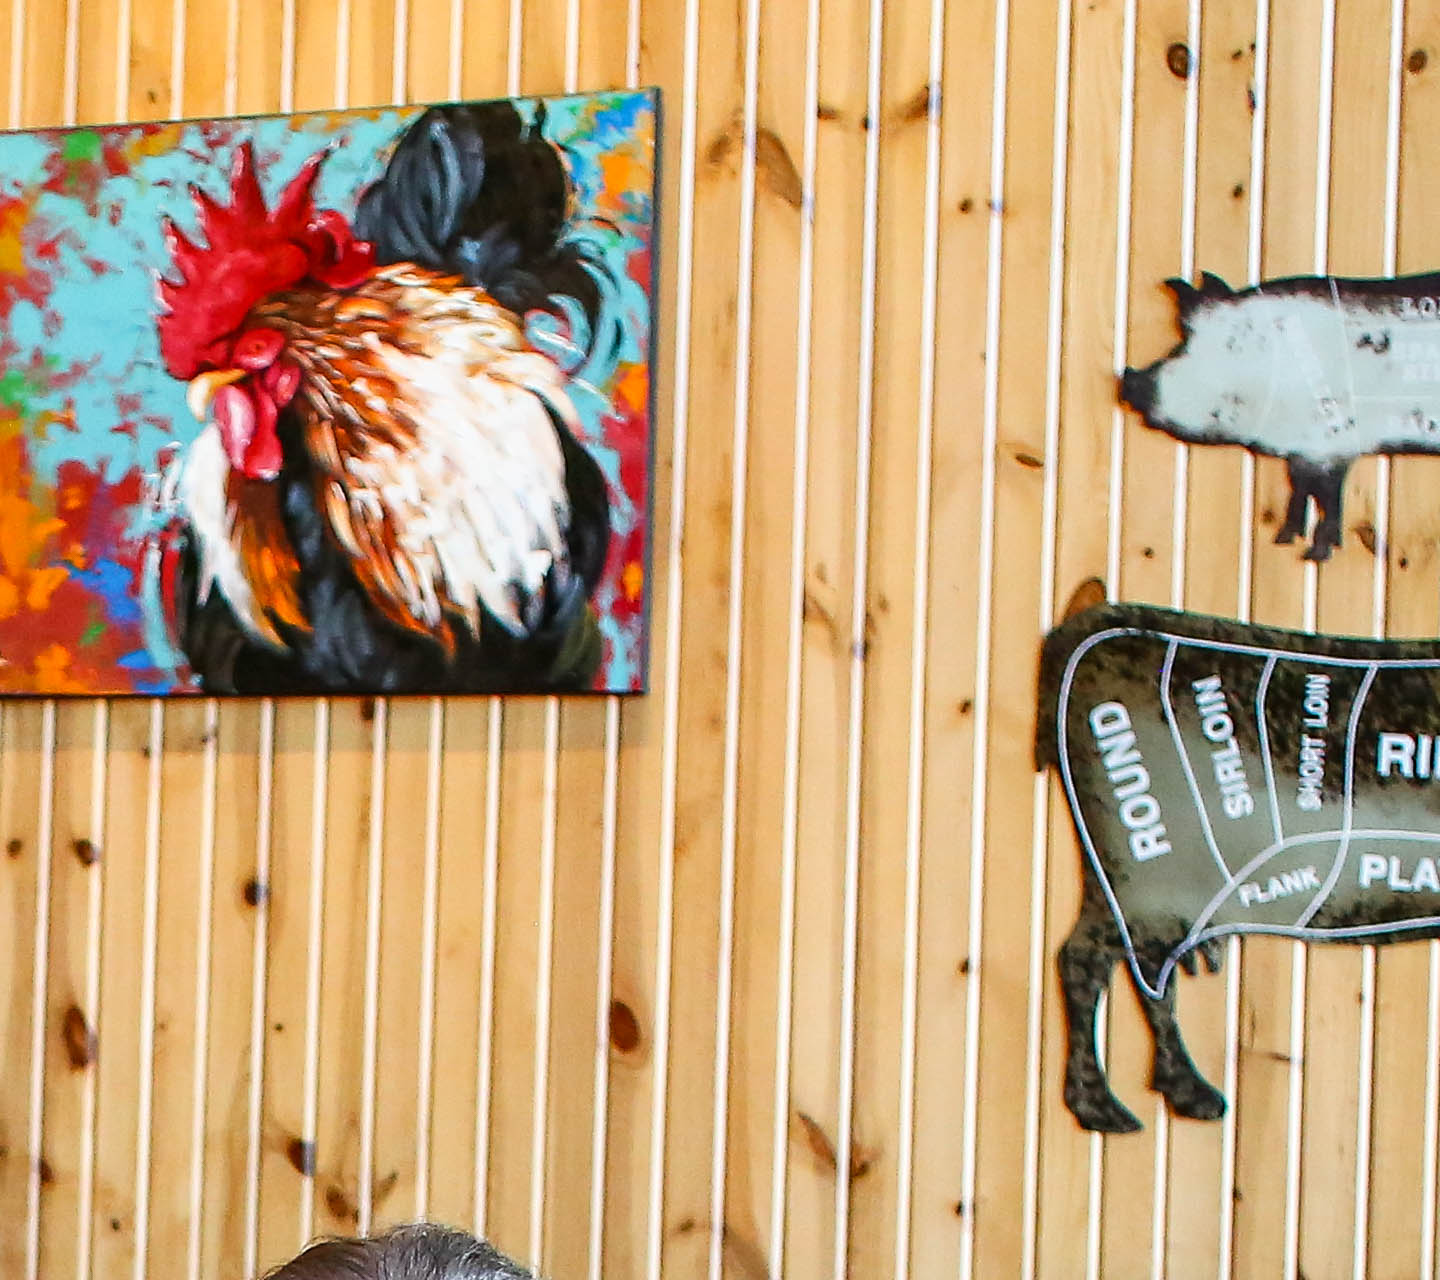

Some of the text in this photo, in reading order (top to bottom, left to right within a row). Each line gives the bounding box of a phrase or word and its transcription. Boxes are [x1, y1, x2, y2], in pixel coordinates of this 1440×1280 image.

[1089, 701, 1172, 862] ROUND
[1191, 675, 1254, 820] SIRLOIN
[1296, 673, 1331, 812] SHORT LOIN
[1238, 865, 1321, 908] FLANK
